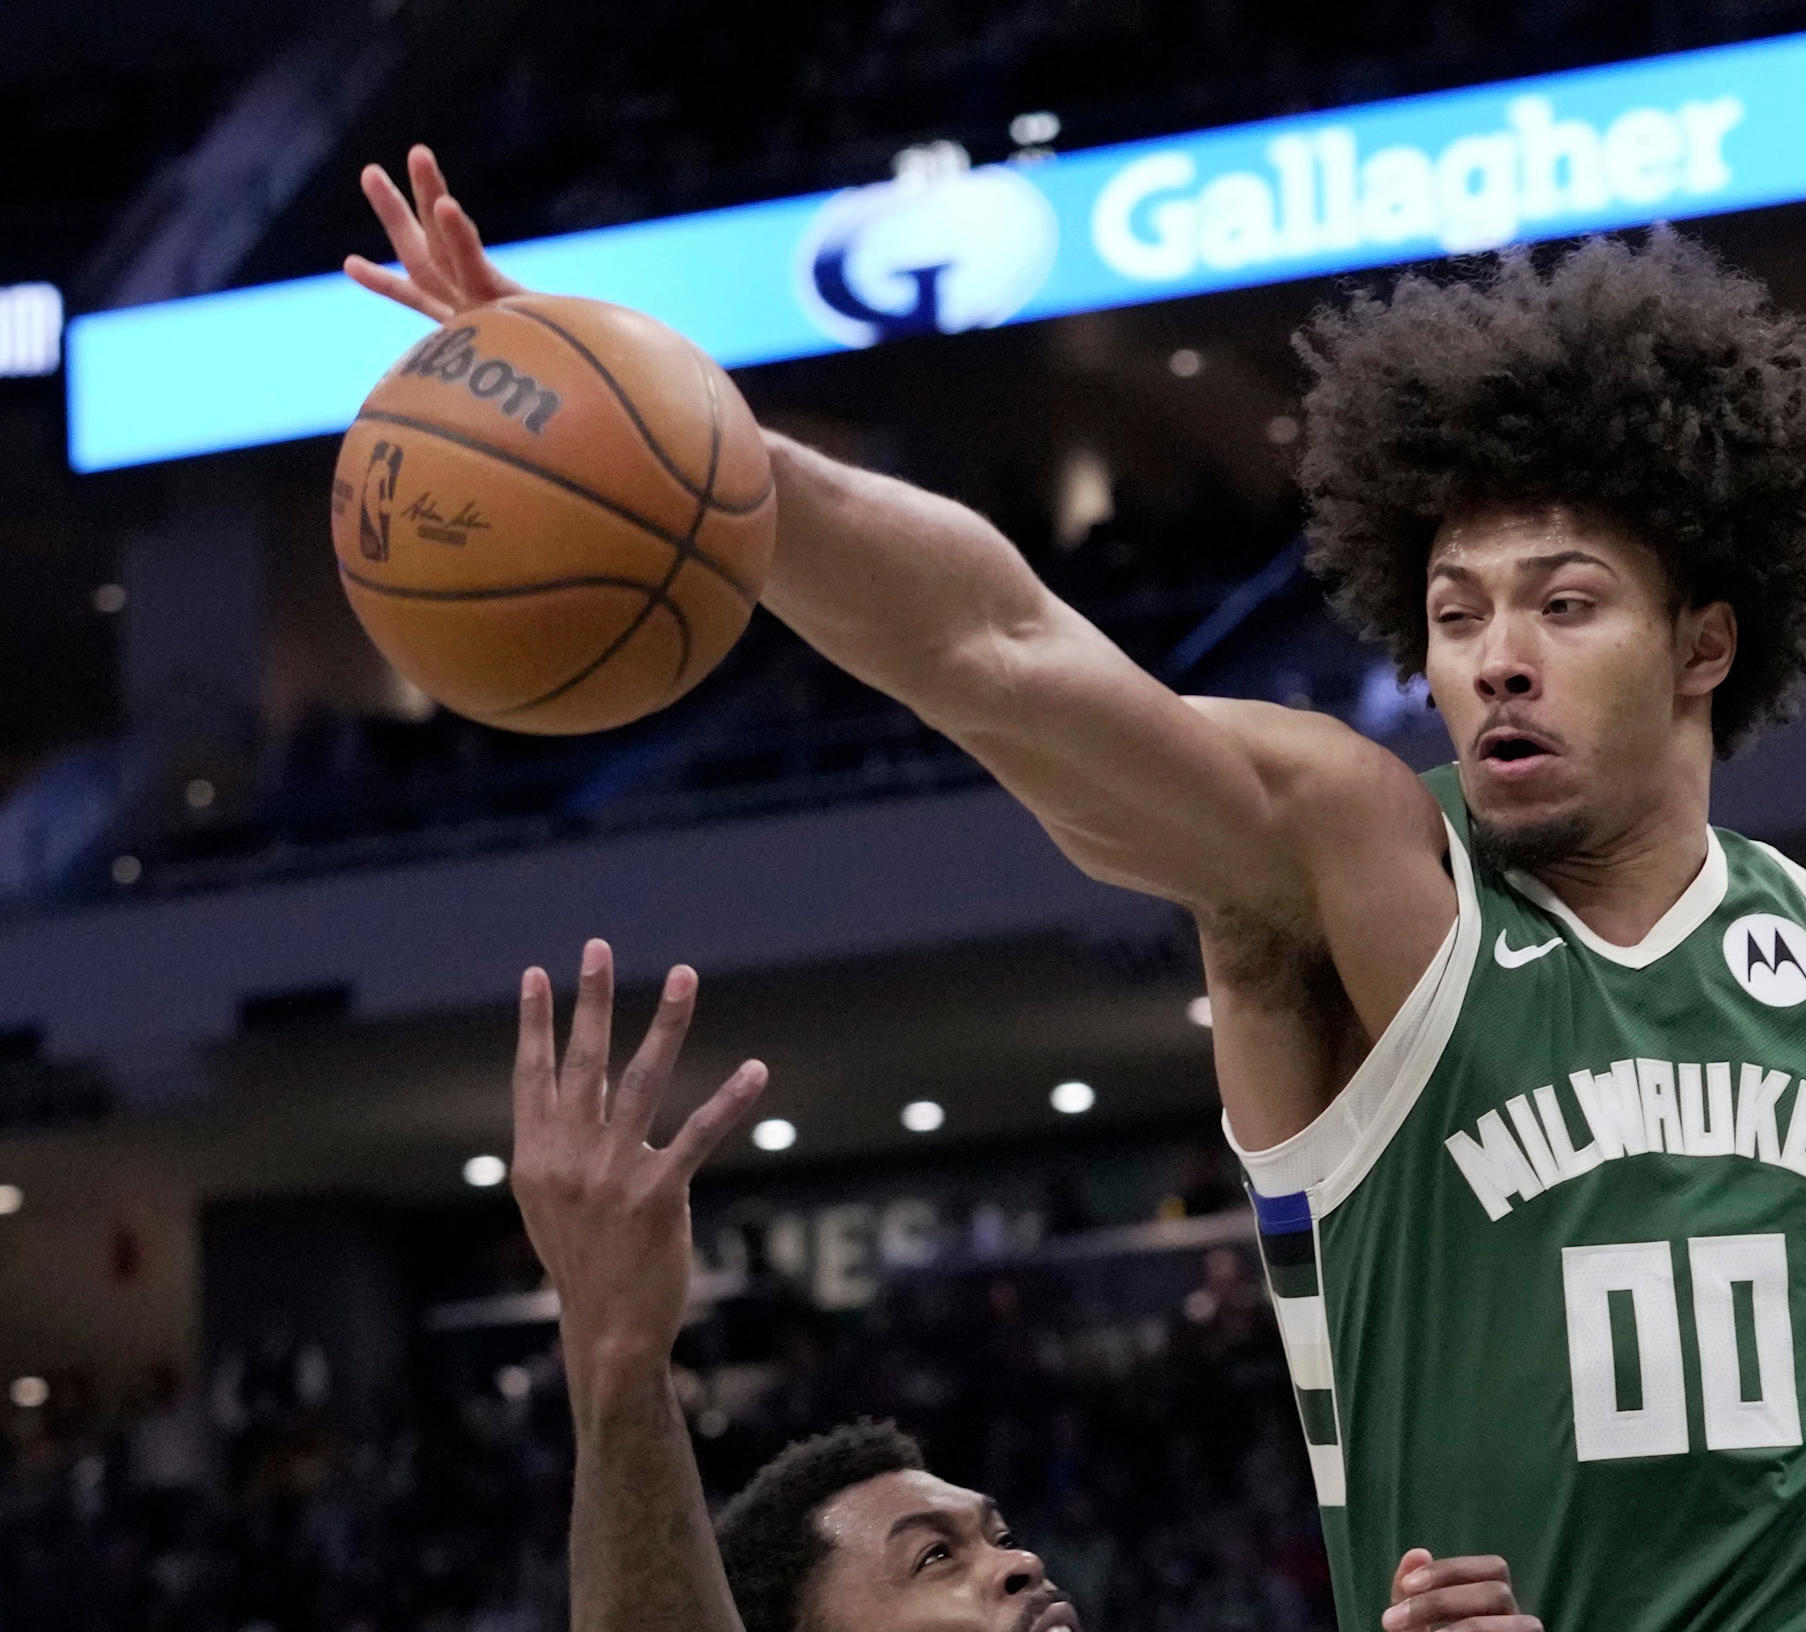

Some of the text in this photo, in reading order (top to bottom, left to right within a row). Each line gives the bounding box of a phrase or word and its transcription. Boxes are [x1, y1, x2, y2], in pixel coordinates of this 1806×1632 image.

[1091, 96, 1743, 282] Gallagher
[401, 325, 562, 437] ilson
[1561, 1232, 1803, 1463] 00
